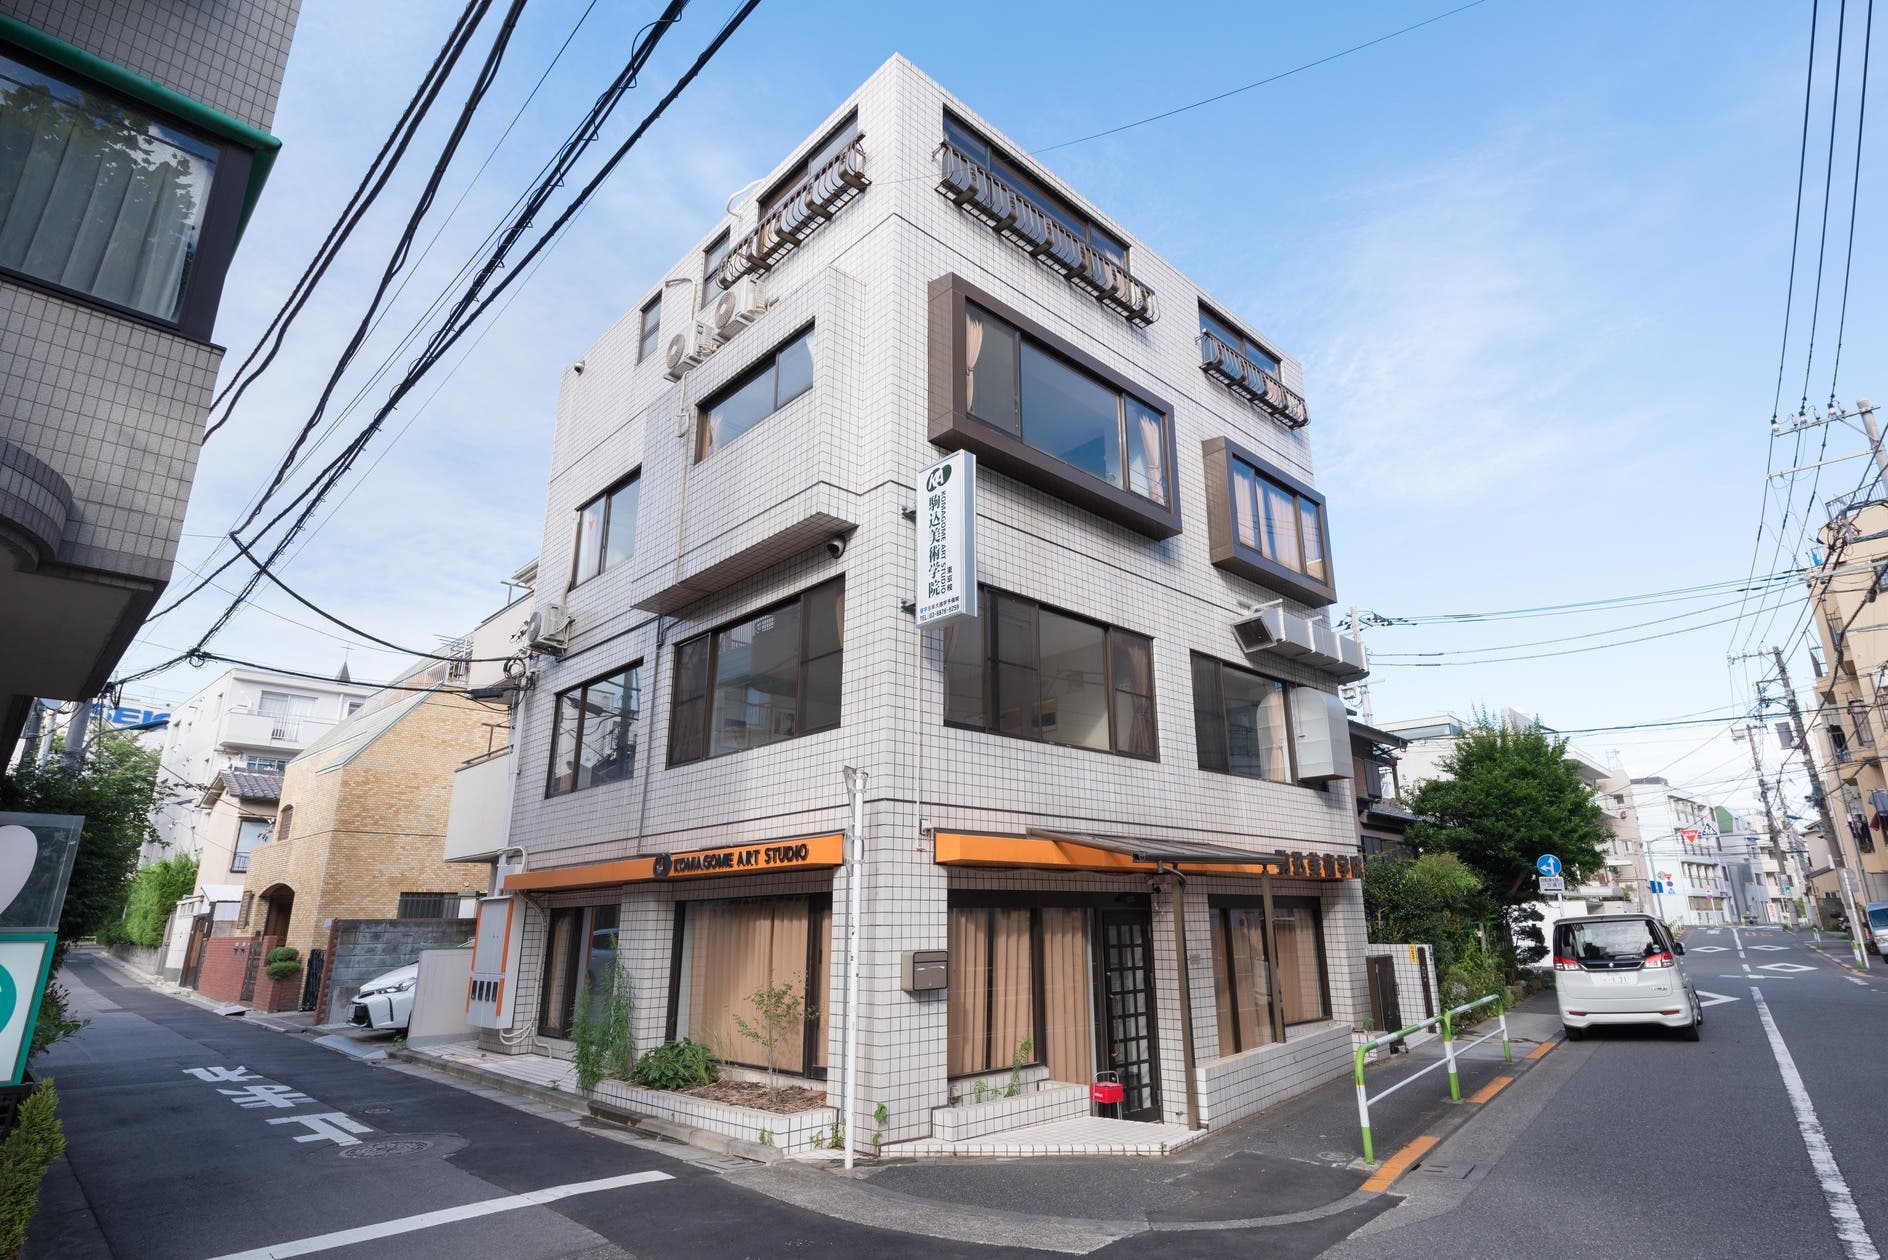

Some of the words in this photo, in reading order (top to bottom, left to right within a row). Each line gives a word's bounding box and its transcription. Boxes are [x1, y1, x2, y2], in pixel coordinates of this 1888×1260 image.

[928, 494, 941, 598] 駒込美術学院
[673, 852, 735, 873] KOMAGOME
[736, 849, 760, 867] ART
[764, 843, 809, 864] STUDIO
